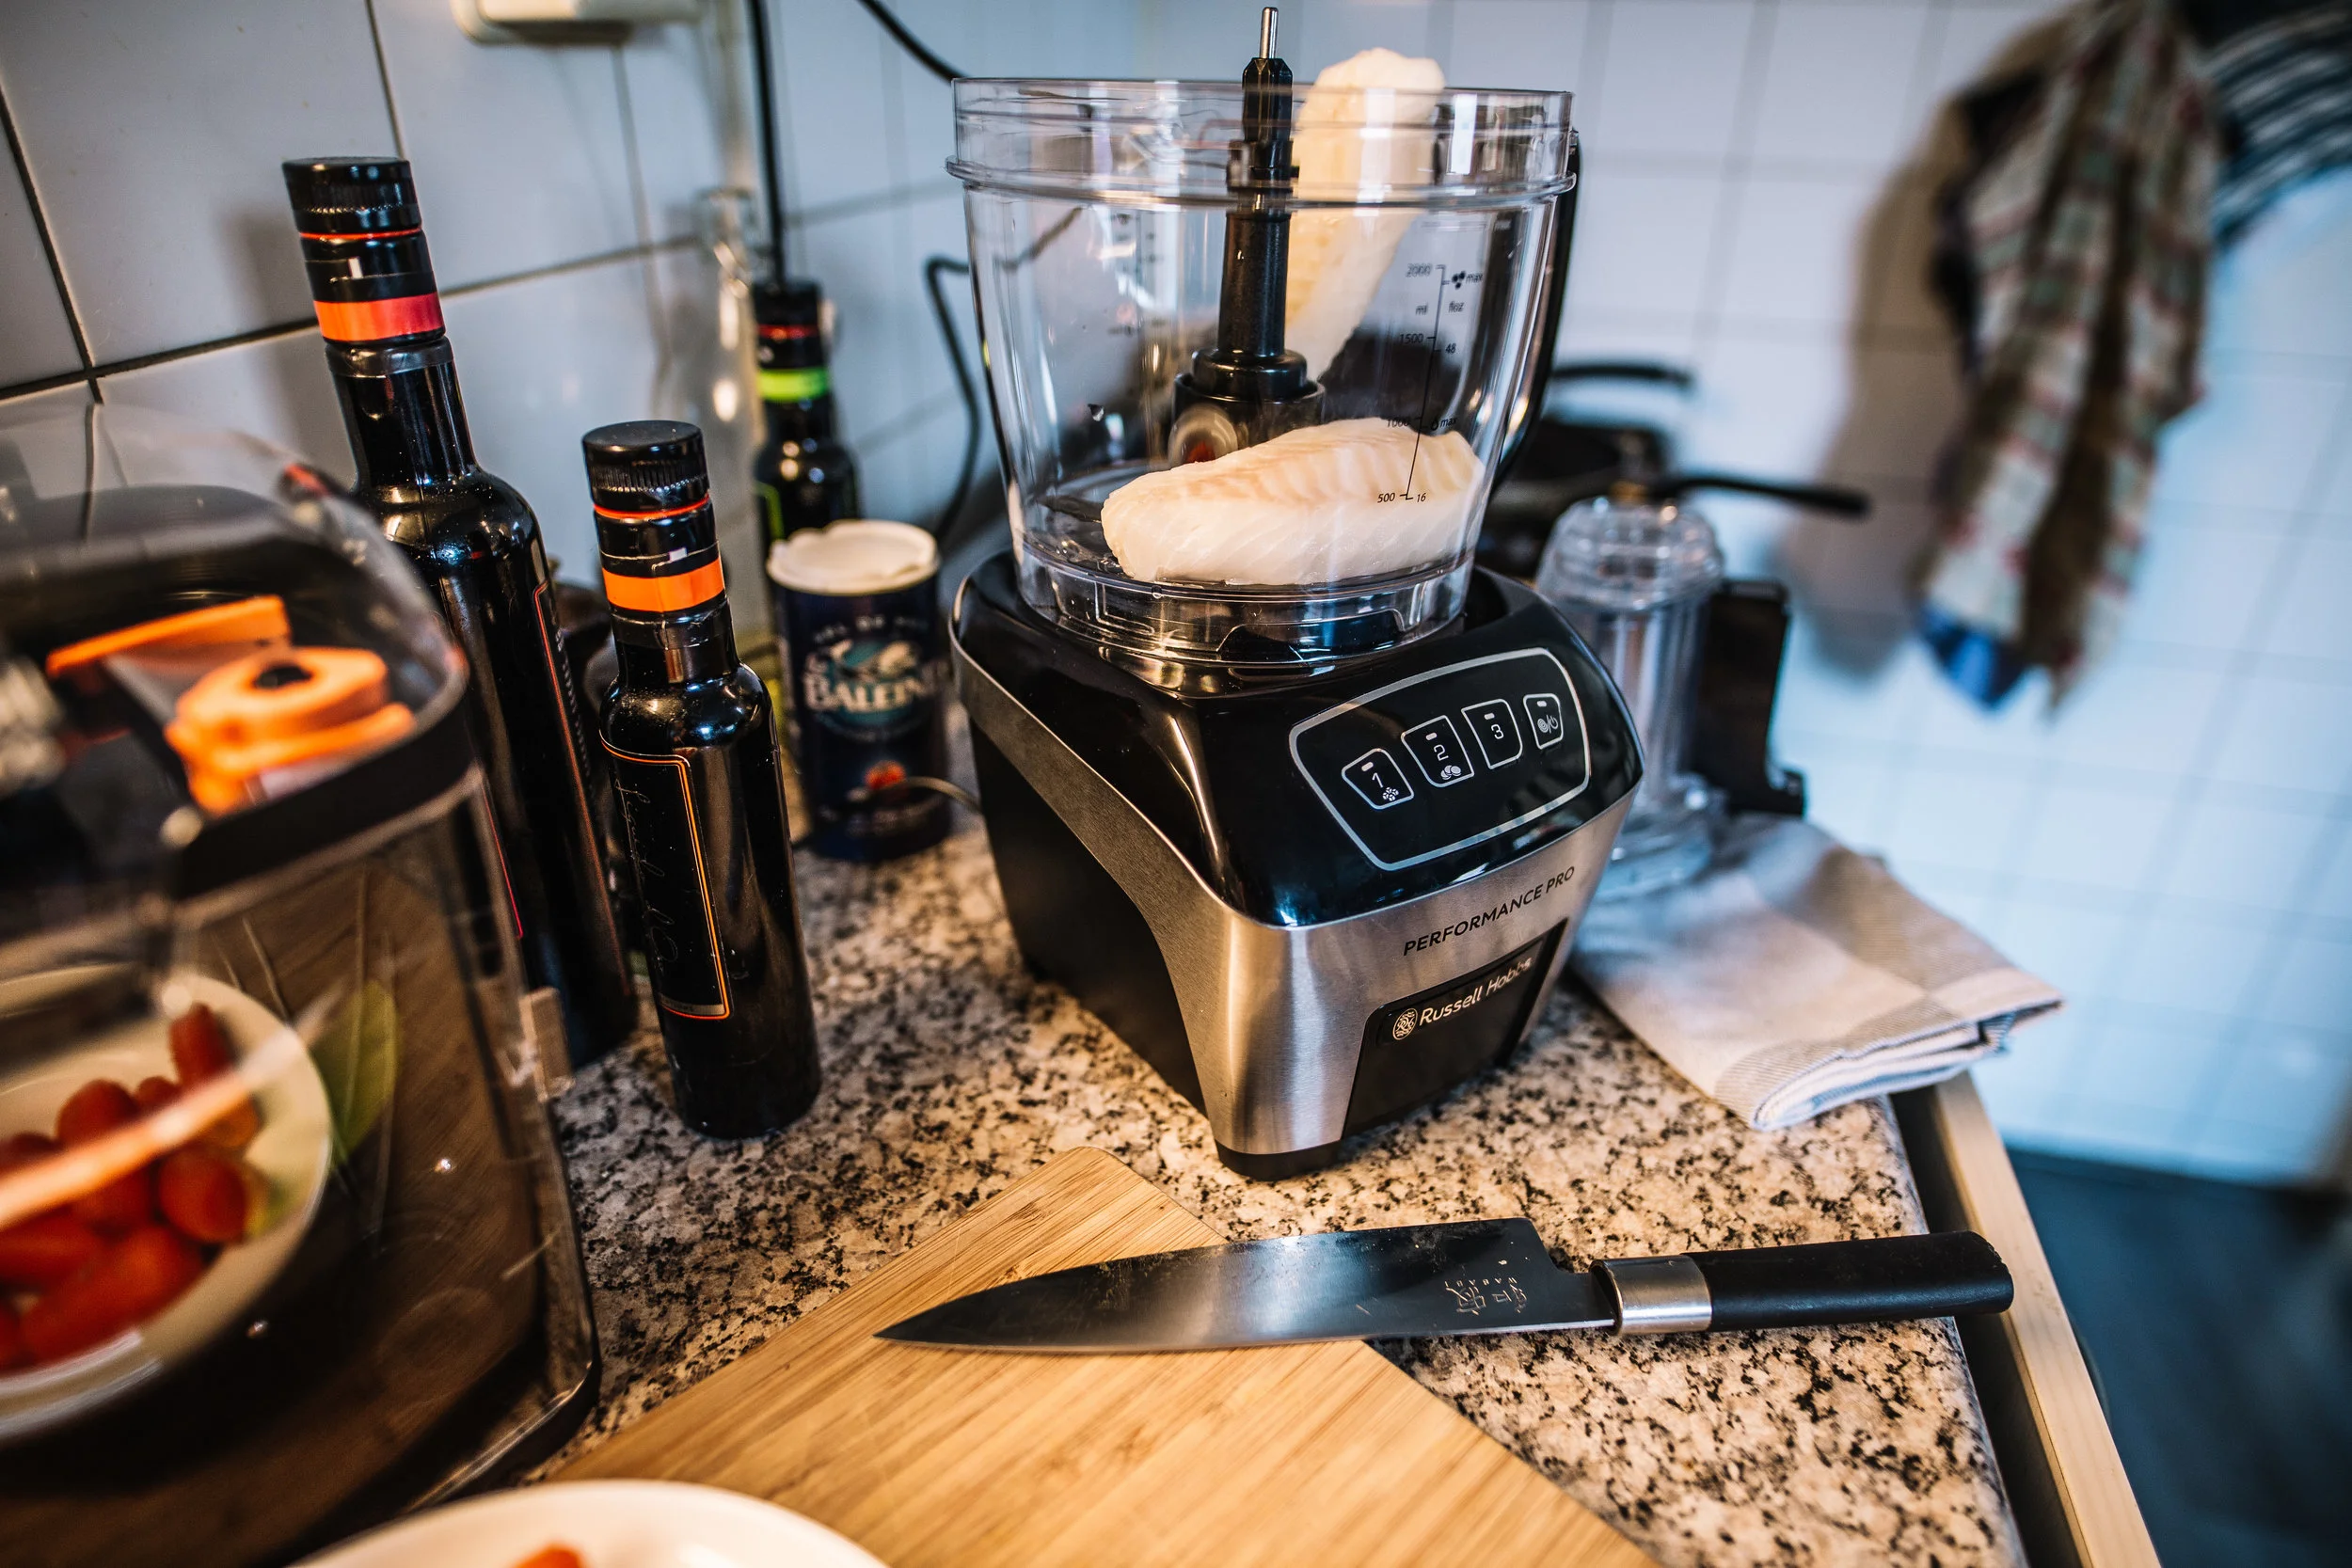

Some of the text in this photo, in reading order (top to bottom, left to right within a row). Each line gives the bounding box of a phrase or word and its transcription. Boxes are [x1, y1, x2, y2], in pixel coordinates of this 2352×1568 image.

[1406, 263, 1431, 277] 2000
[1400, 333, 1424, 343] 1500
[1446, 343, 1456, 354] 48
[1387, 418, 1409, 428] 1000
[1440, 418, 1457, 427] max
[1377, 493, 1396, 503] 500
[1417, 493, 1426, 502] 16
[1492, 723, 1504, 739] 3
[1434, 744, 1449, 761] 2
[1372, 772, 1383, 787] 1
[1403, 866, 1575, 957] PERFORMANCE PRO
[1419, 986, 1484, 1026] Russell
